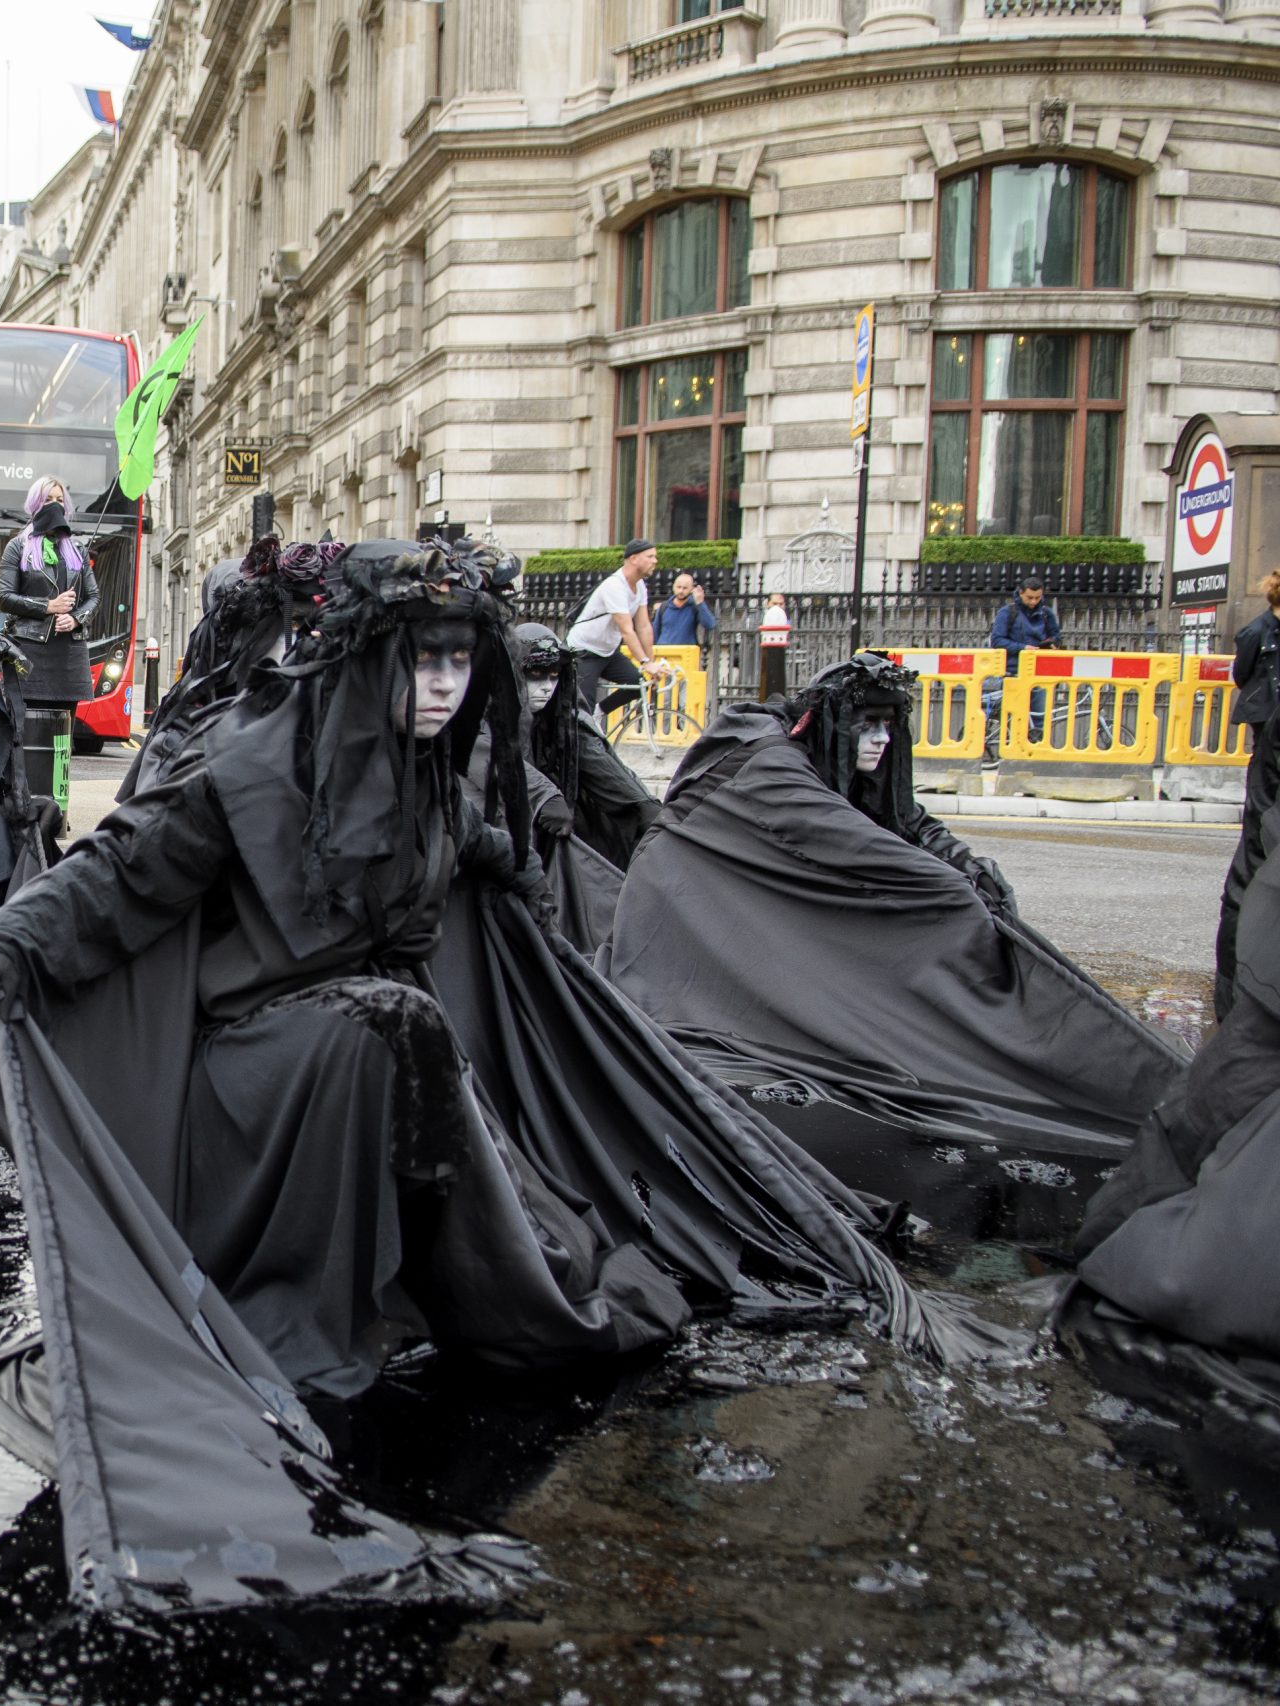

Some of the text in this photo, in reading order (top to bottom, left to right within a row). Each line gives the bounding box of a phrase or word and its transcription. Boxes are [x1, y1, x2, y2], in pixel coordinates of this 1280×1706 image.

[1181, 485, 1231, 514] UNDERGROUND
[1176, 573, 1227, 595] BANK STATION
